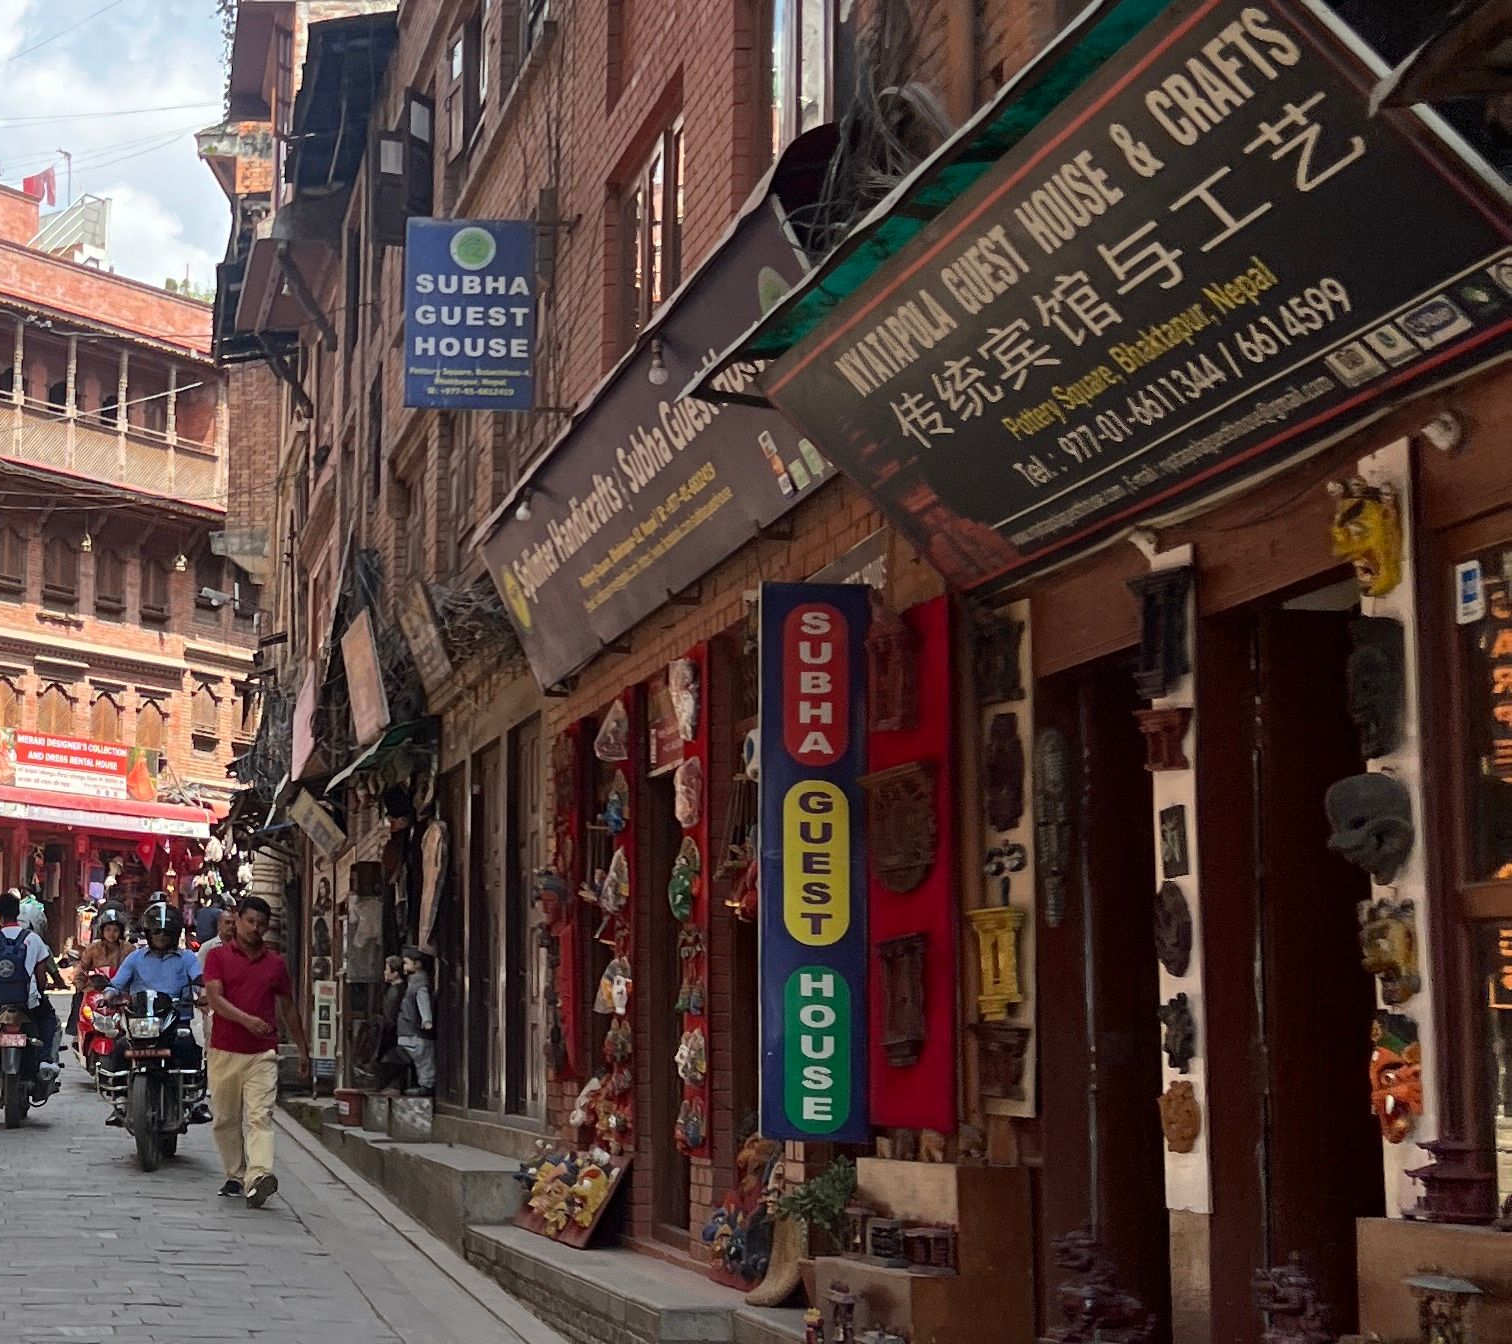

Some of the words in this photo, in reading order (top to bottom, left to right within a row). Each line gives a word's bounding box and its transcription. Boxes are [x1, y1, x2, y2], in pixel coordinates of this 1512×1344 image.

[834, 288, 958, 399] NYATAPOLA
[942, 222, 1032, 315] GUEST
[1015, 150, 1125, 254] HOUSE
[1109, 122, 1165, 178] &
[1145, 6, 1303, 146] CRAFTS
[414, 305, 530, 327] GUEST
[414, 336, 529, 358] HOUSE
[415, 274, 530, 296] SUBHA
[1002, 393, 1061, 443] Pottery
[1055, 357, 1123, 414] Square,
[1109, 296, 1224, 382] Bhaktapur,
[1202, 256, 1280, 318] Nepal
[1243, 276, 1353, 373] 6614599
[546, 469, 624, 562] Handicrafts
[616, 423, 674, 495] Subha
[798, 610, 834, 755] SUBHA
[798, 790, 834, 937] GUEST
[800, 973, 837, 1122] HOUSE
